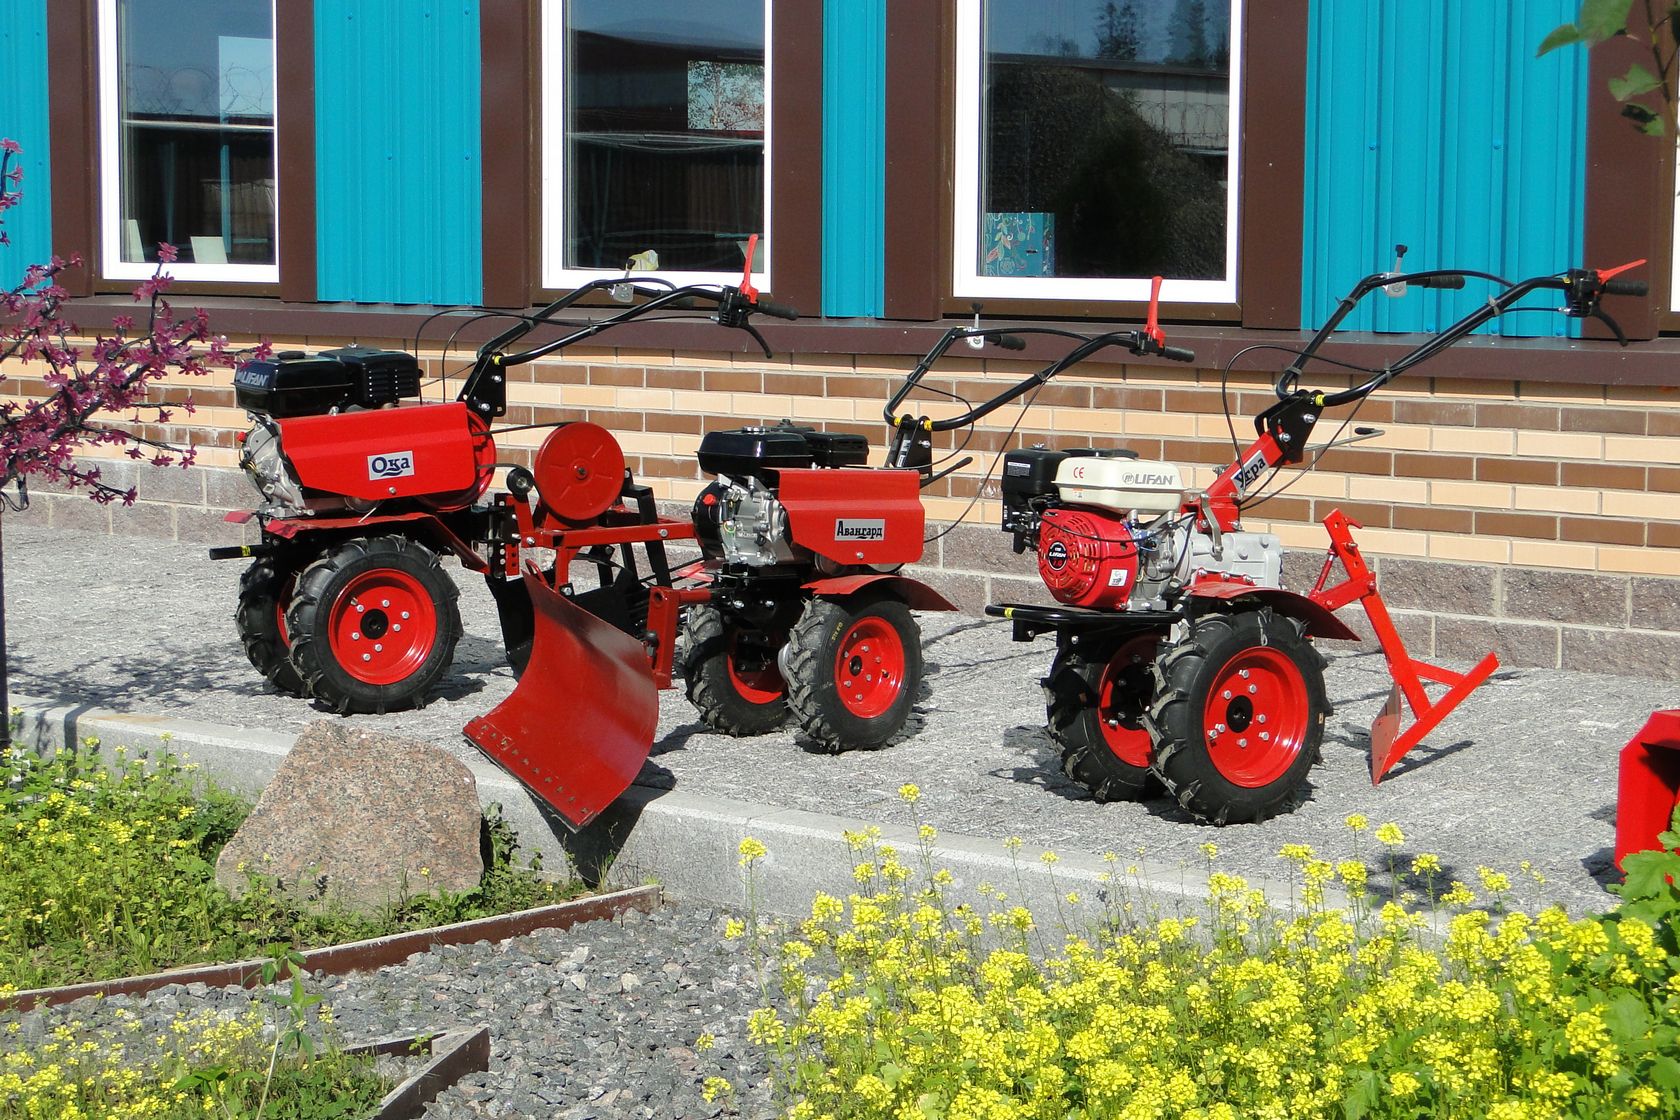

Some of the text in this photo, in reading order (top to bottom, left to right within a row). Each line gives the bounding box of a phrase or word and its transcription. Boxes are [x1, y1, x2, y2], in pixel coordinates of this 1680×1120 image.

[241, 371, 268, 386] LIFAN
[371, 456, 411, 476] Ока
[1233, 457, 1266, 488] Угра
[1134, 474, 1173, 485] LIFAN
[836, 520, 883, 539] Авангард
